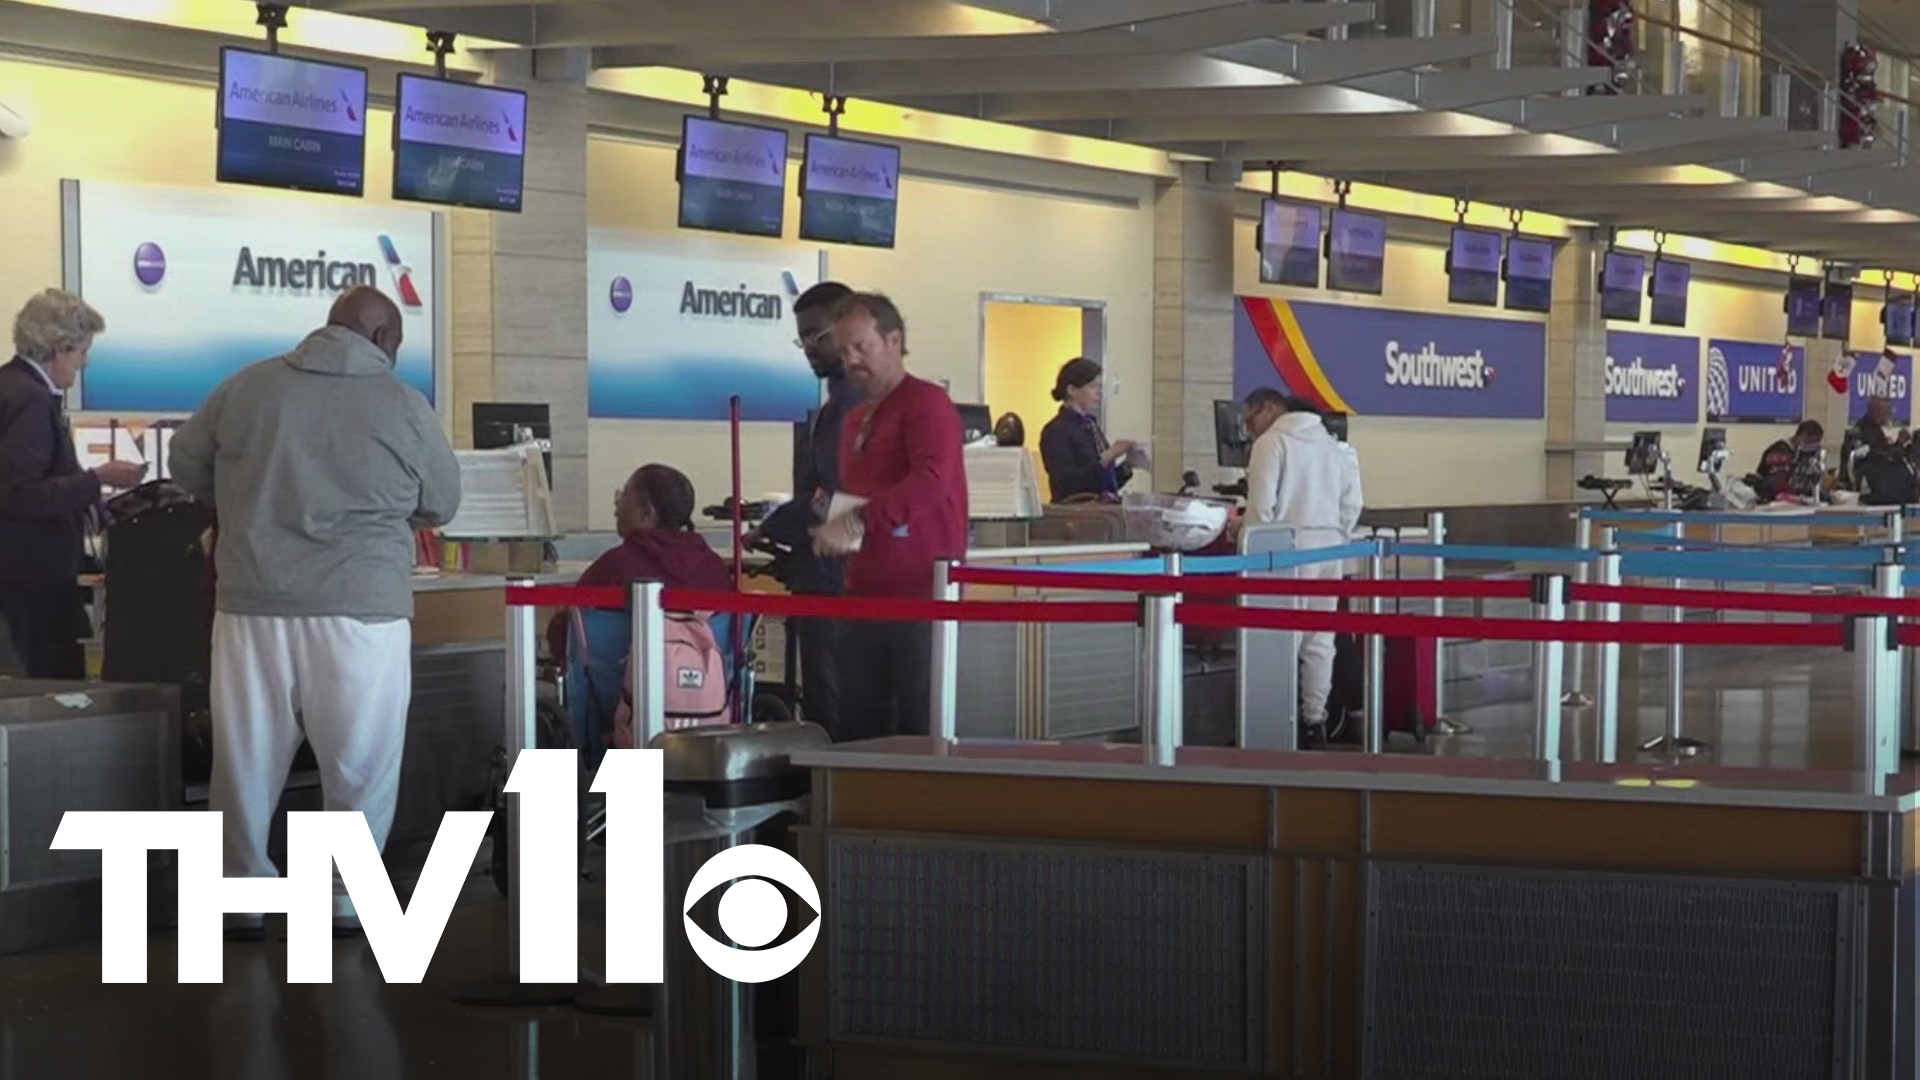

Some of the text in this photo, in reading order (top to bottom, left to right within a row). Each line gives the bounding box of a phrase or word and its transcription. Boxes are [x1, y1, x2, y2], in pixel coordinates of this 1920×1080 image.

[233, 247, 376, 291] American
[679, 280, 782, 320] American
[1385, 340, 1484, 388] Southwest
[1605, 356, 1678, 397] Southwest
[1857, 372, 1906, 399] UNED
